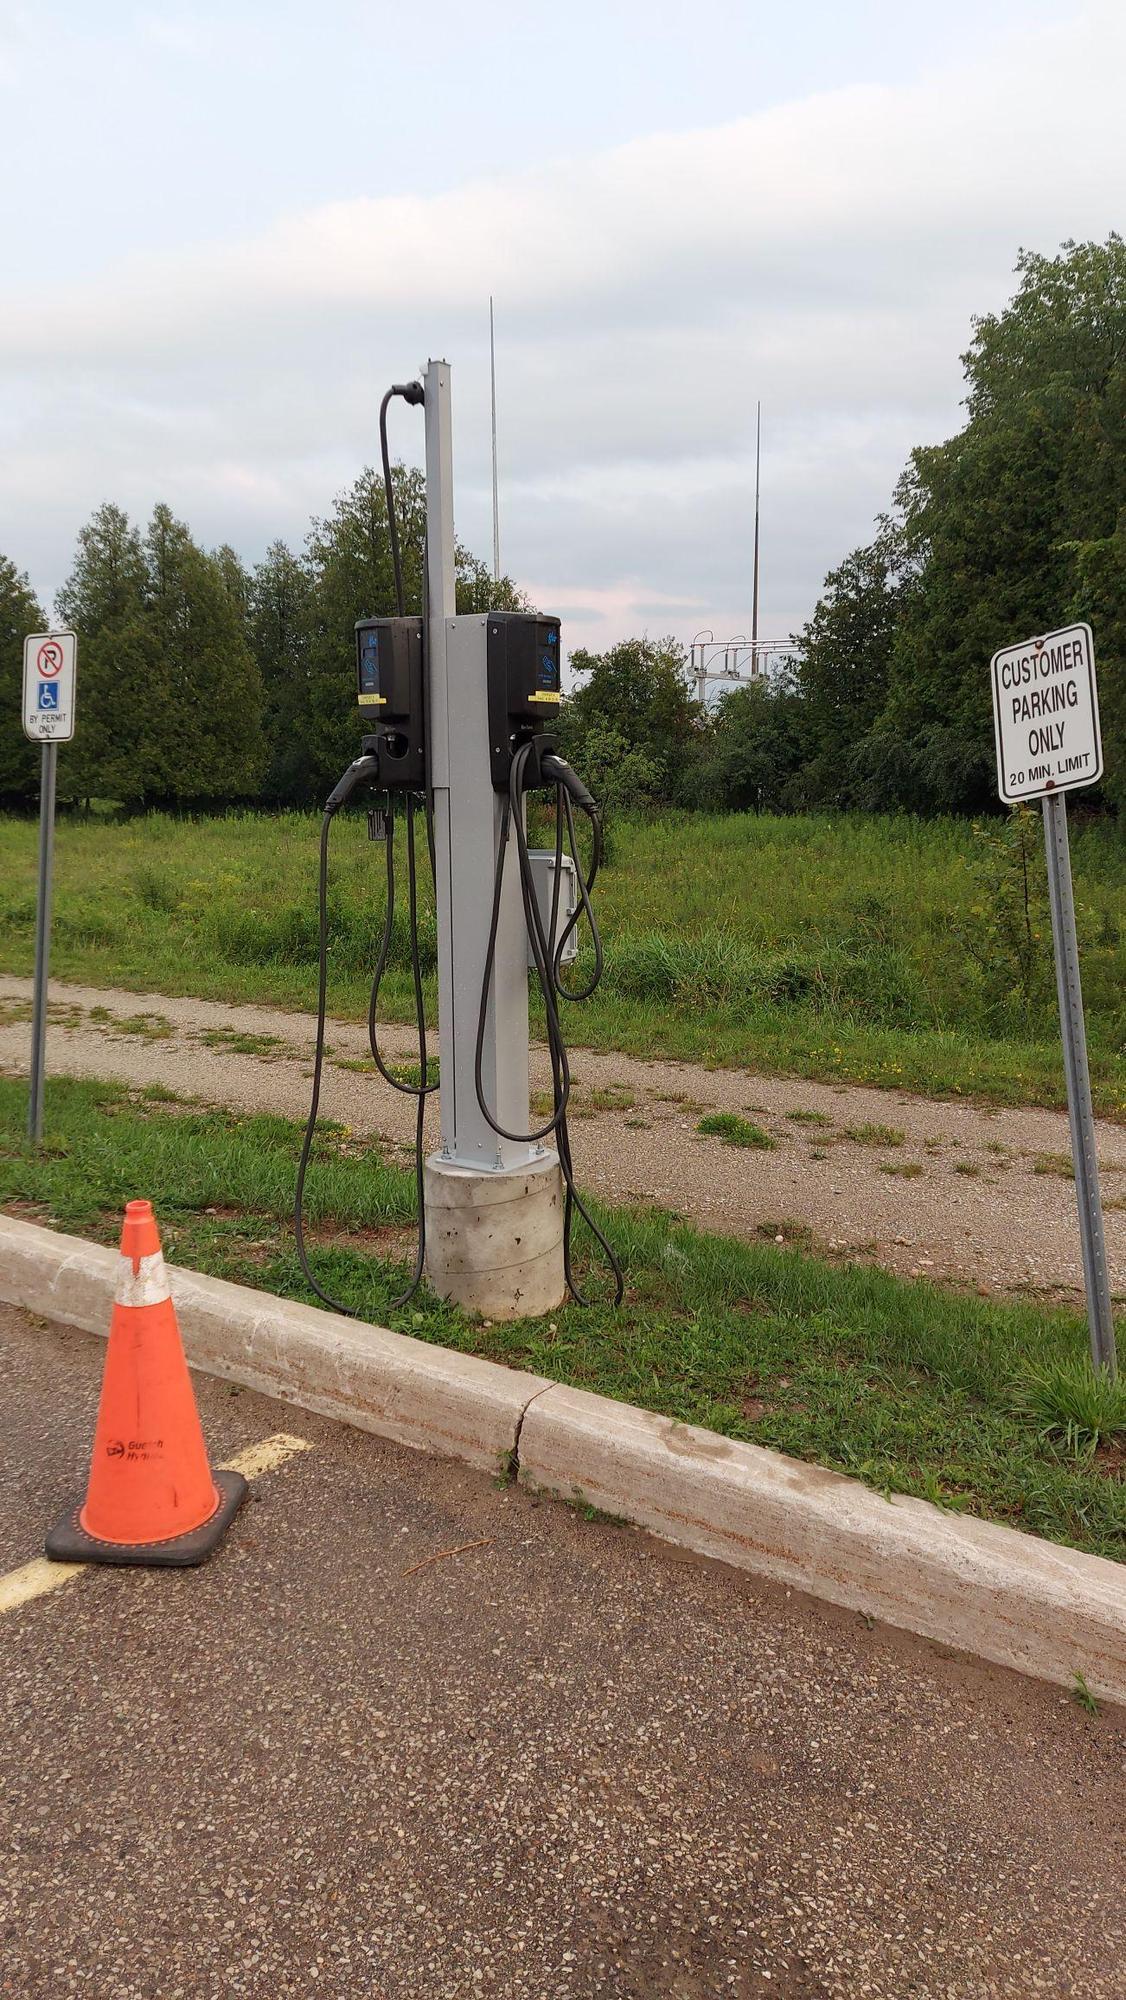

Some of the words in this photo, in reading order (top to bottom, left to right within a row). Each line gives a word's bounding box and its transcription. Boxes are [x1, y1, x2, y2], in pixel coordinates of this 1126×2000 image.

[1002, 640, 1083, 689] CUSTOMER
[29, 715, 37, 724] BY
[42, 713, 67, 723] PERMIT
[1013, 680, 1078, 724] PARKING
[39, 725, 55, 734] ONLY
[1028, 721, 1065, 756] ONLY
[1010, 772, 1025, 786] 20
[1029, 764, 1054, 781] MIN.
[1058, 753, 1090, 774] LIMIT
